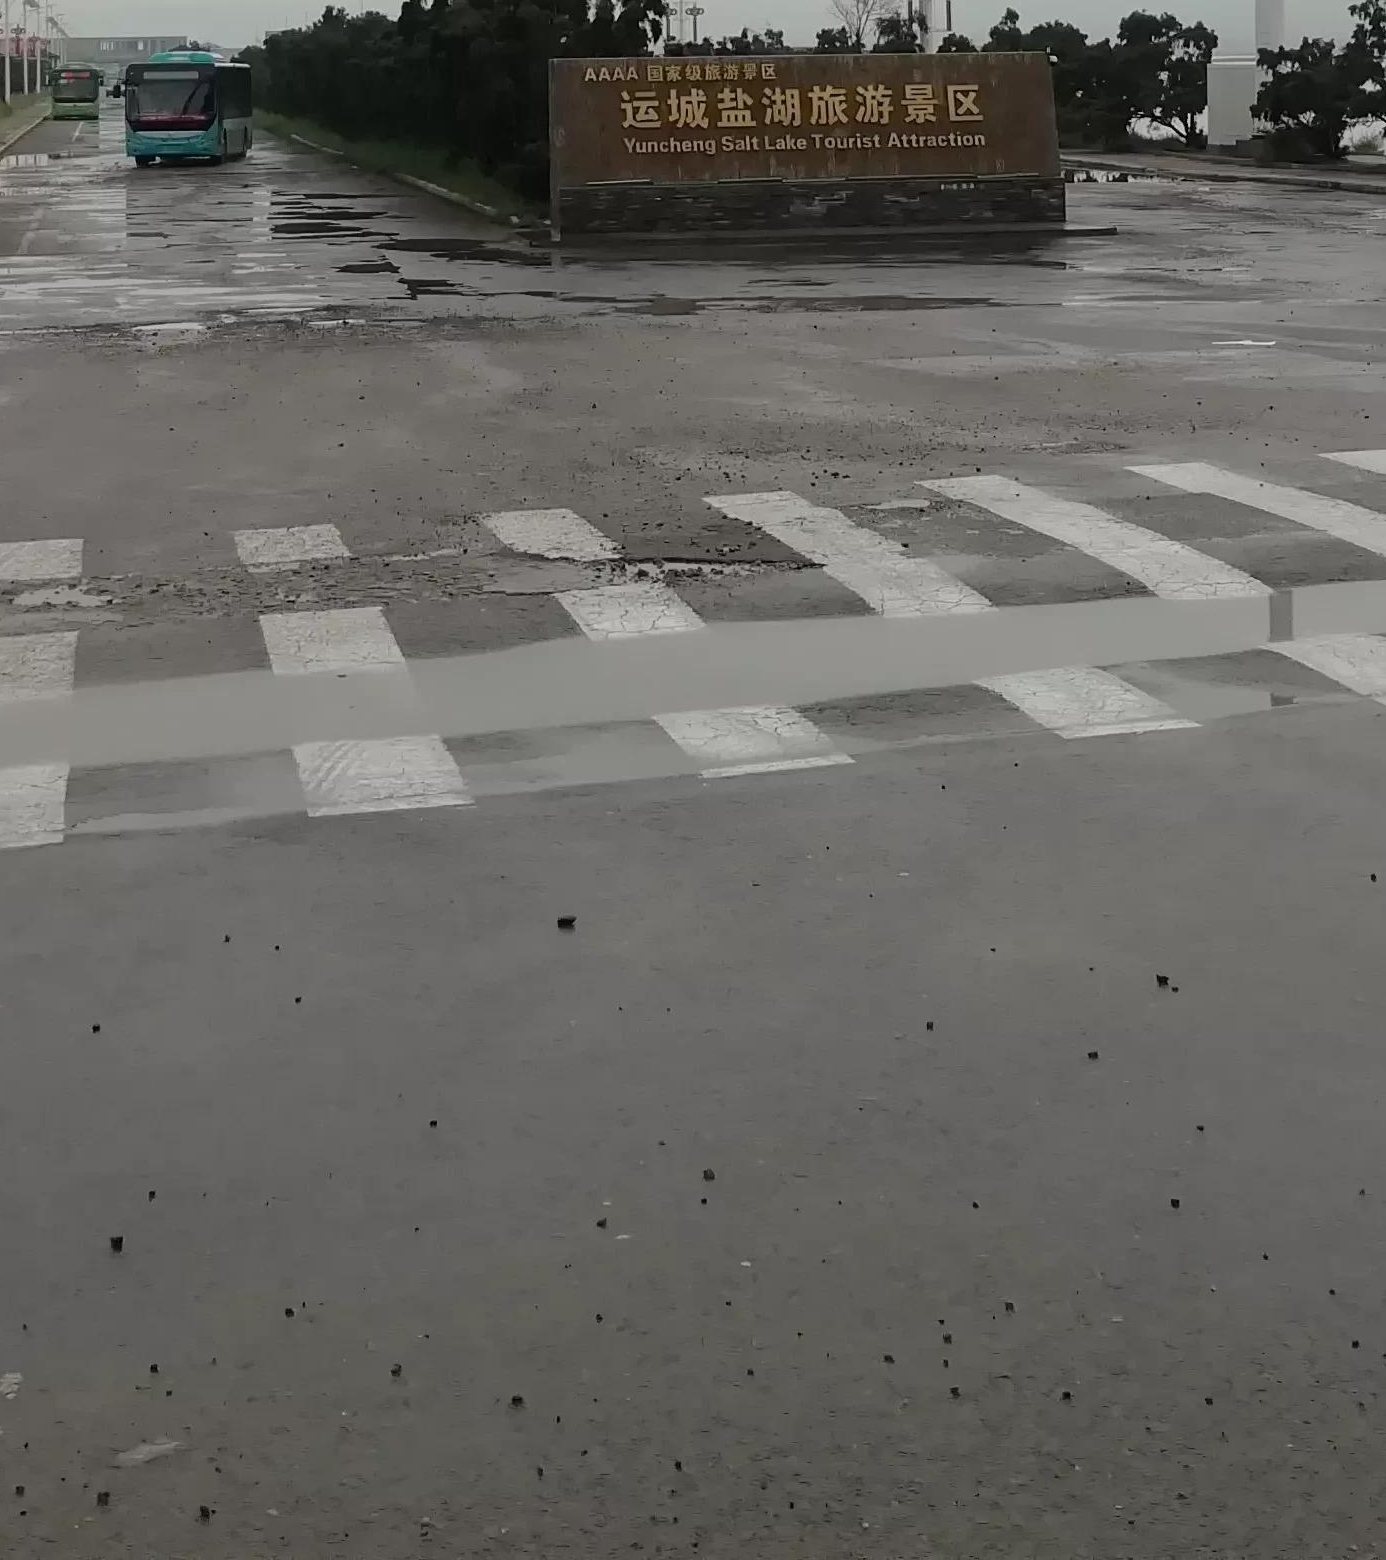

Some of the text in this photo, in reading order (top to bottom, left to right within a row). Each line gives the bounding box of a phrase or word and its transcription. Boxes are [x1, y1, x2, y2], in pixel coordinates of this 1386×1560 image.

[584, 63, 777, 82] AAAA 国家级旅游景区
[620, 84, 984, 129] 运城盐湖旅游景区
[624, 131, 985, 154] Yuncheng Salt Lake Tourist Attraction
